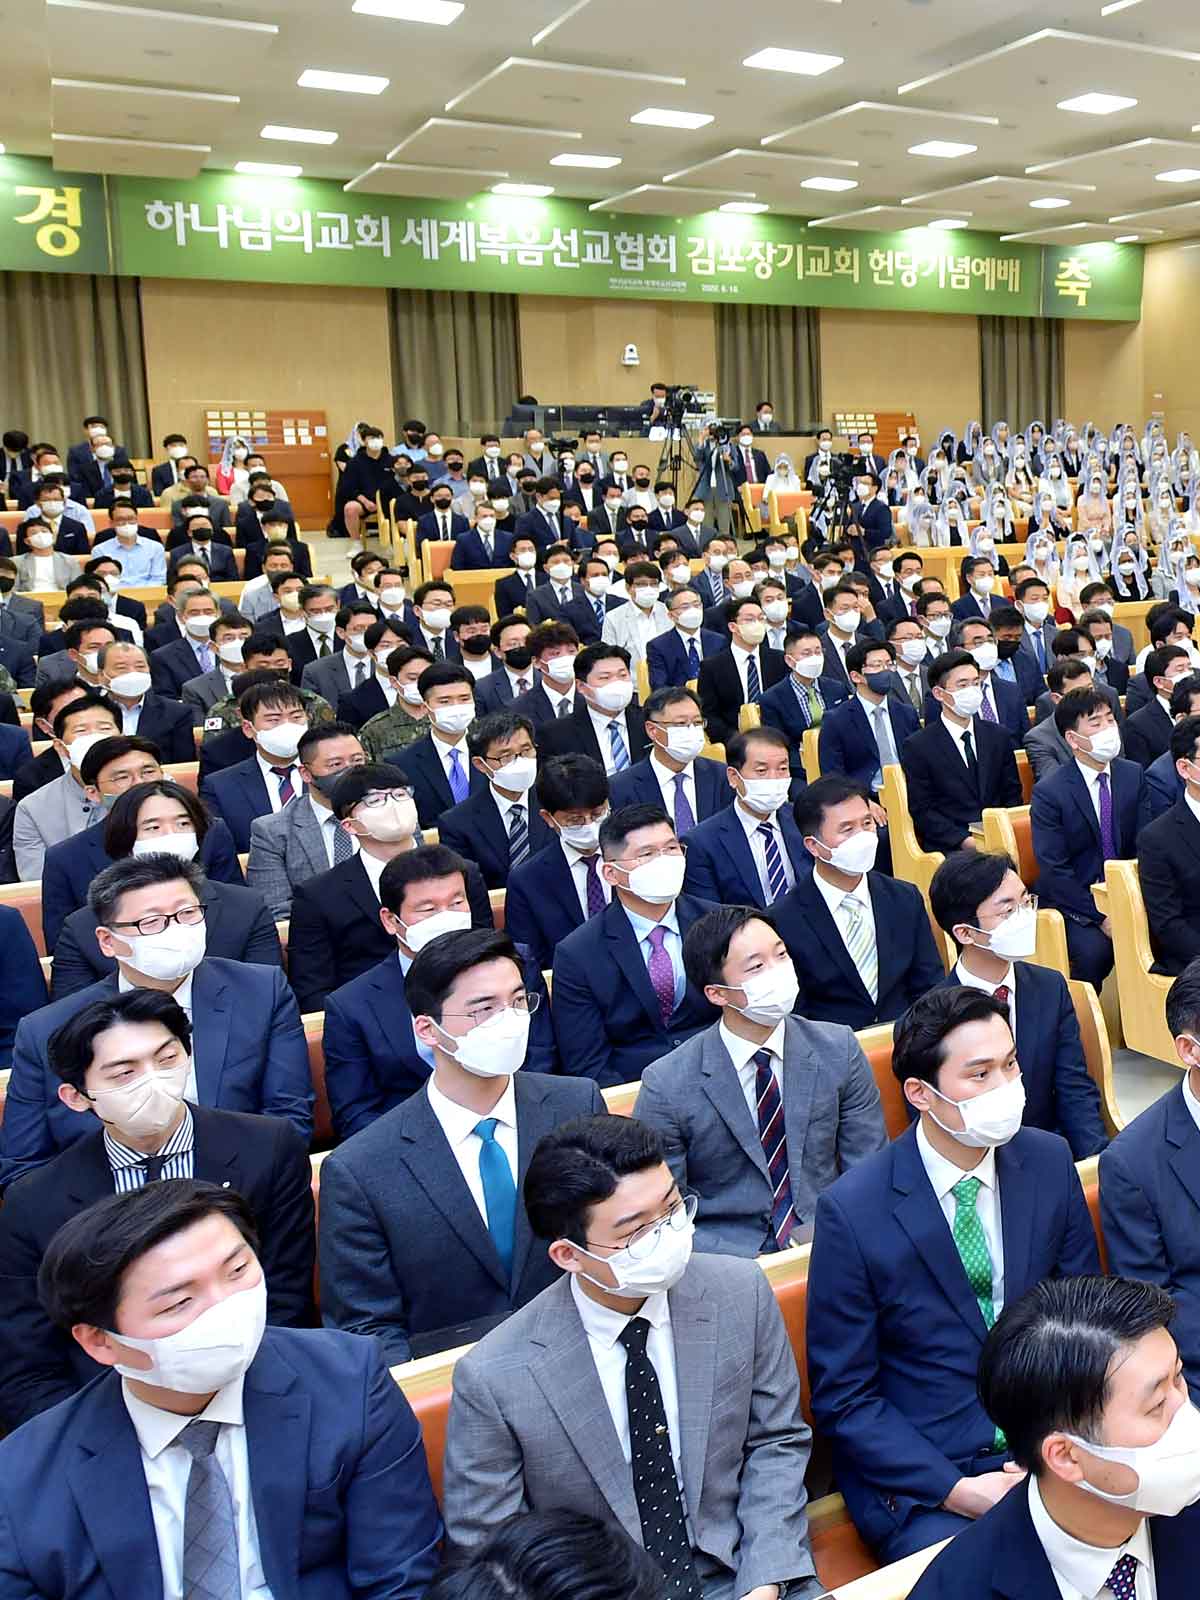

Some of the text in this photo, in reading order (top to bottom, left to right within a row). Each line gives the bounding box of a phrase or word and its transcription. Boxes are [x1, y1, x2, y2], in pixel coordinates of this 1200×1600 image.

[14, 185, 82, 257] 경
[144, 200, 1020, 292] 하나님의교회 세계복음선교협회 김포장기교회 헌당기념예배
[1055, 257, 1092, 306] 축
